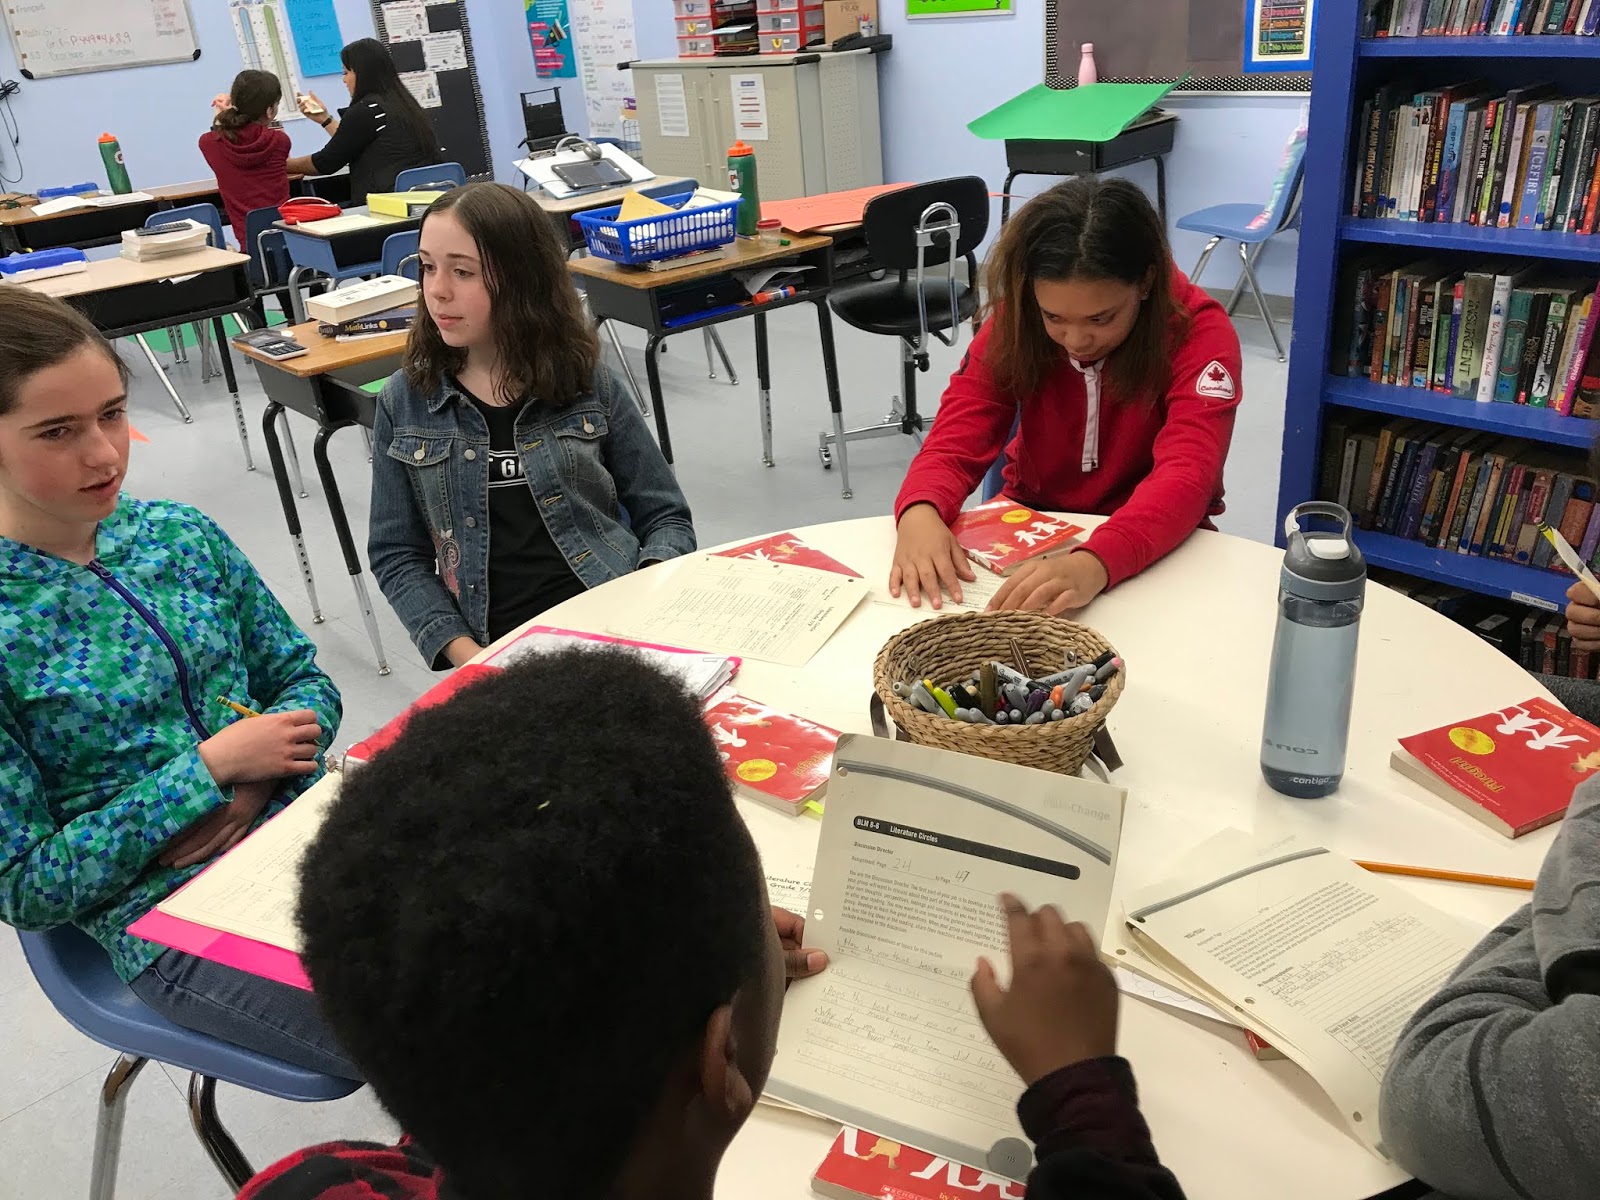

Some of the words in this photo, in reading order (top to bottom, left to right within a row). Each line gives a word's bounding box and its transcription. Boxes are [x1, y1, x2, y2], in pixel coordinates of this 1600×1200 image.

[1480, 141, 1488, 158] JUVIE
[1363, 164, 1375, 192] CAMERA
[1477, 160, 1485, 178] THREE
[1526, 150, 1544, 195] ICEFIRE
[1459, 299, 1479, 375] INSURGENT
[1293, 776, 1330, 786] contigo
[1450, 757, 1505, 792] Firegirl
[856, 818, 868, 826] BLM
[890, 825, 917, 838] Literature
[918, 832, 938, 842] Circles
